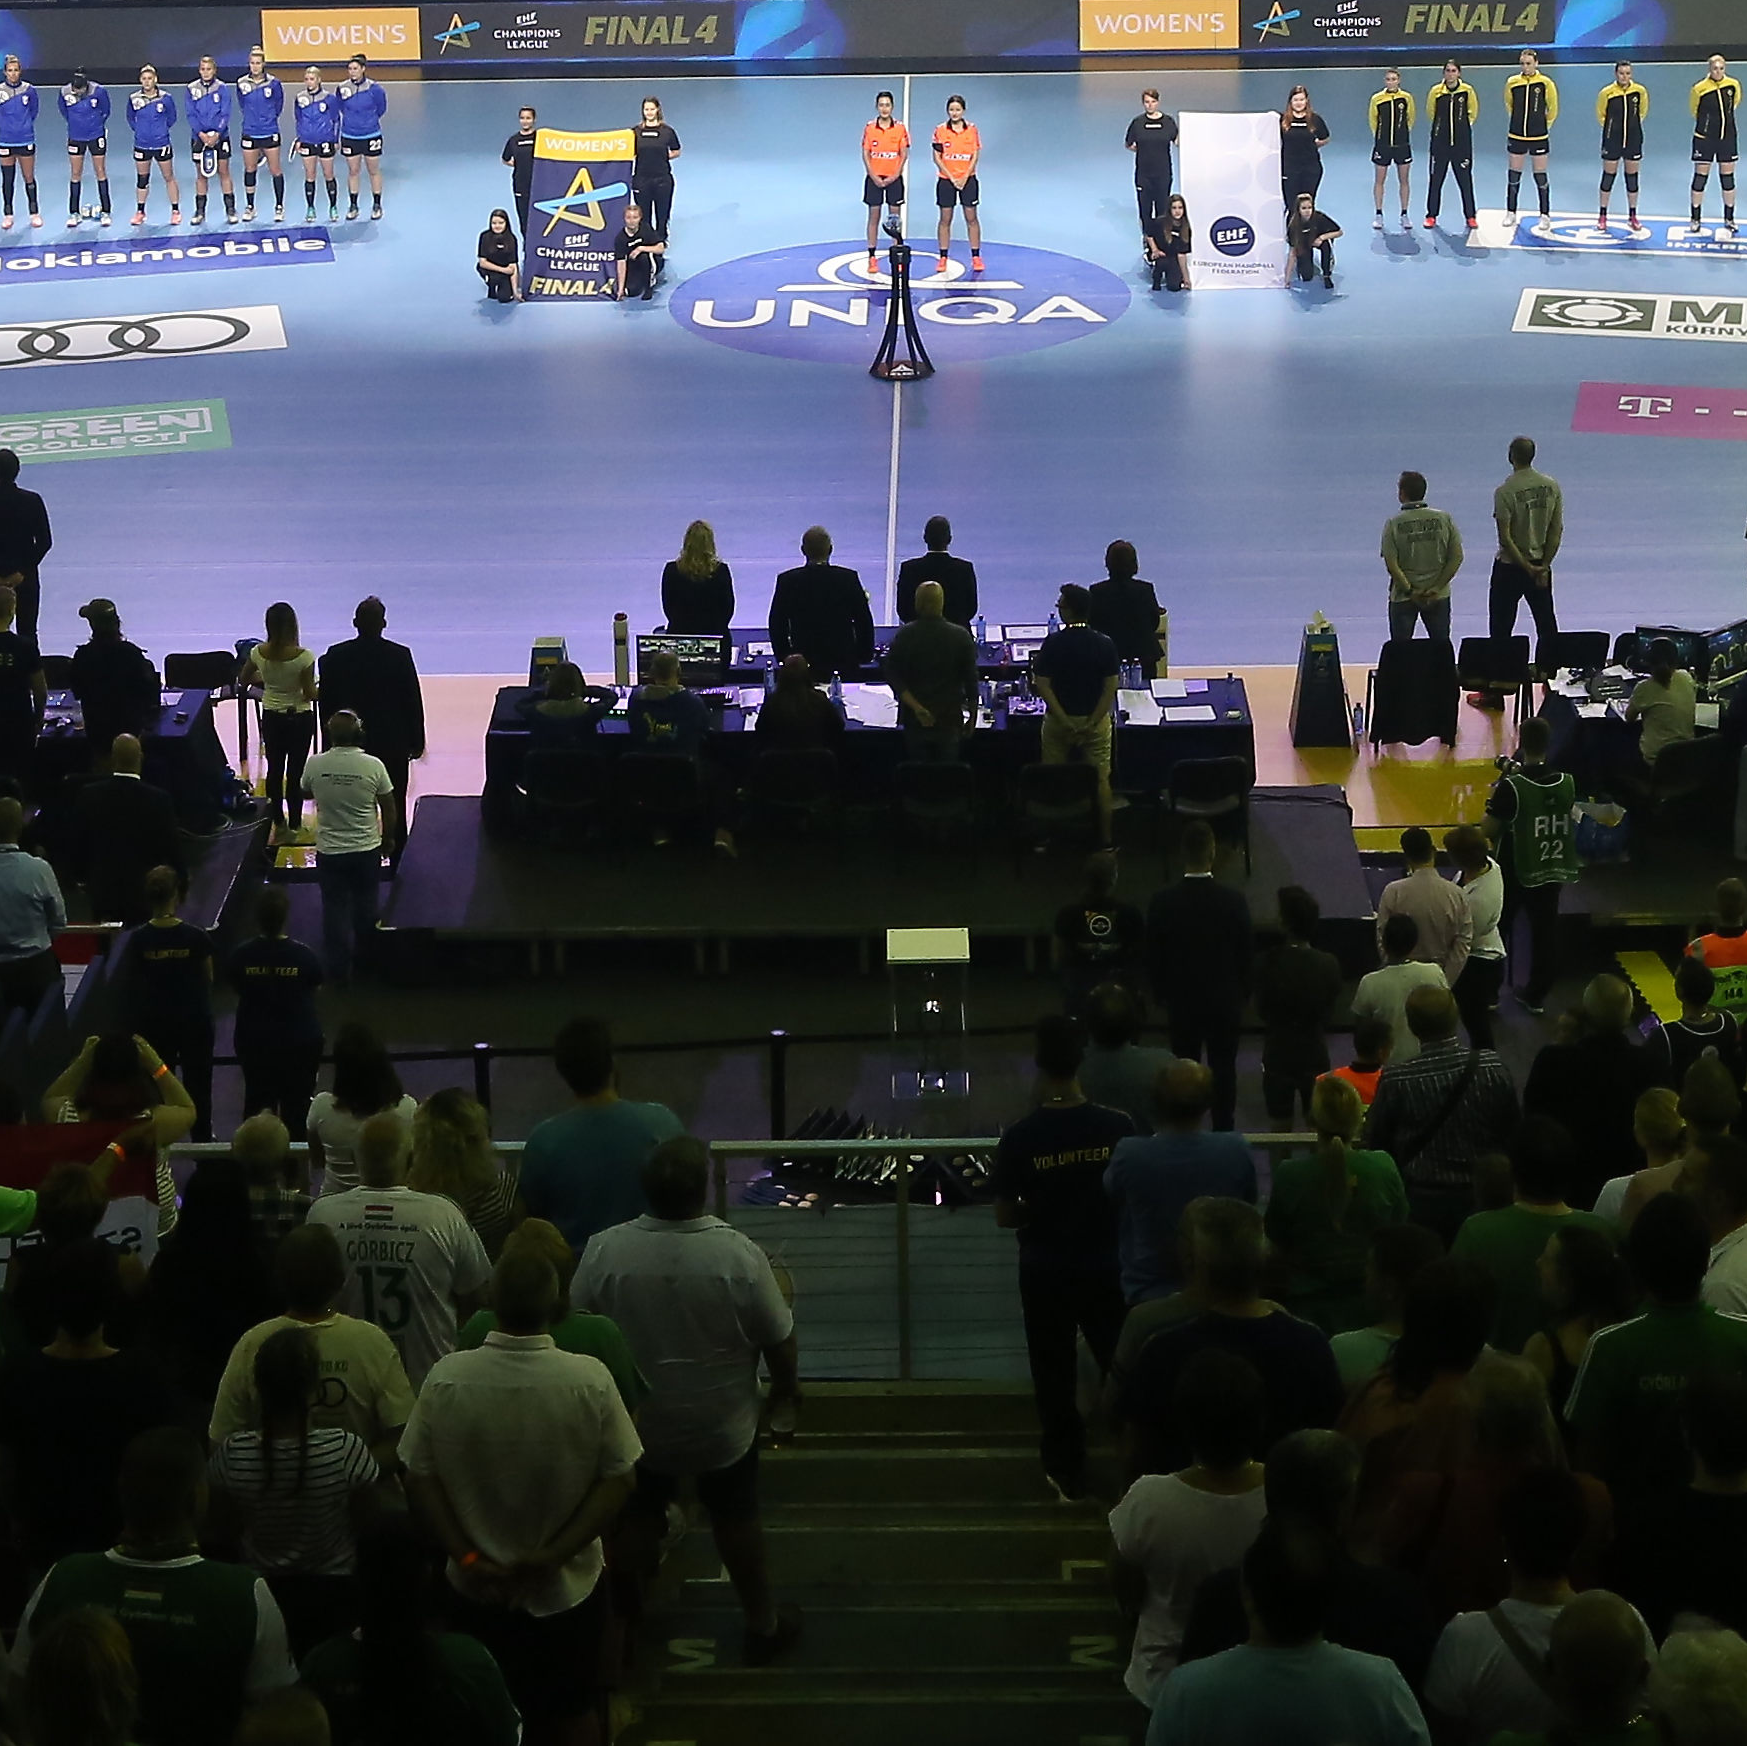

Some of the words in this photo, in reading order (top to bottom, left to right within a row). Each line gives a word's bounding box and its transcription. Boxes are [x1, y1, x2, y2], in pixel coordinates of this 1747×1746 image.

[1094, 12, 1226, 35] WOMEN'S
[1313, 16, 1382, 28] CHAMPIONS
[277, 24, 407, 46] WOMEN'S
[493, 28, 562, 40] CHAMPIONS
[1326, 27, 1370, 38] LEAGUE
[506, 39, 550, 50] LEAGUE
[544, 137, 628, 153] WOMEN'S
[564, 233, 590, 248] EHF
[1215, 226, 1249, 246] EHF
[536, 246, 615, 262] CHAMPIONS
[550, 259, 600, 272] LEAGUE
[1534, 814, 1570, 839] RH
[1538, 839, 1565, 862] 22
[1033, 1145, 1112, 1171] VOLUNTEER
[346, 1236, 415, 1265] GÖRBICZ
[357, 1267, 412, 1330] 13
